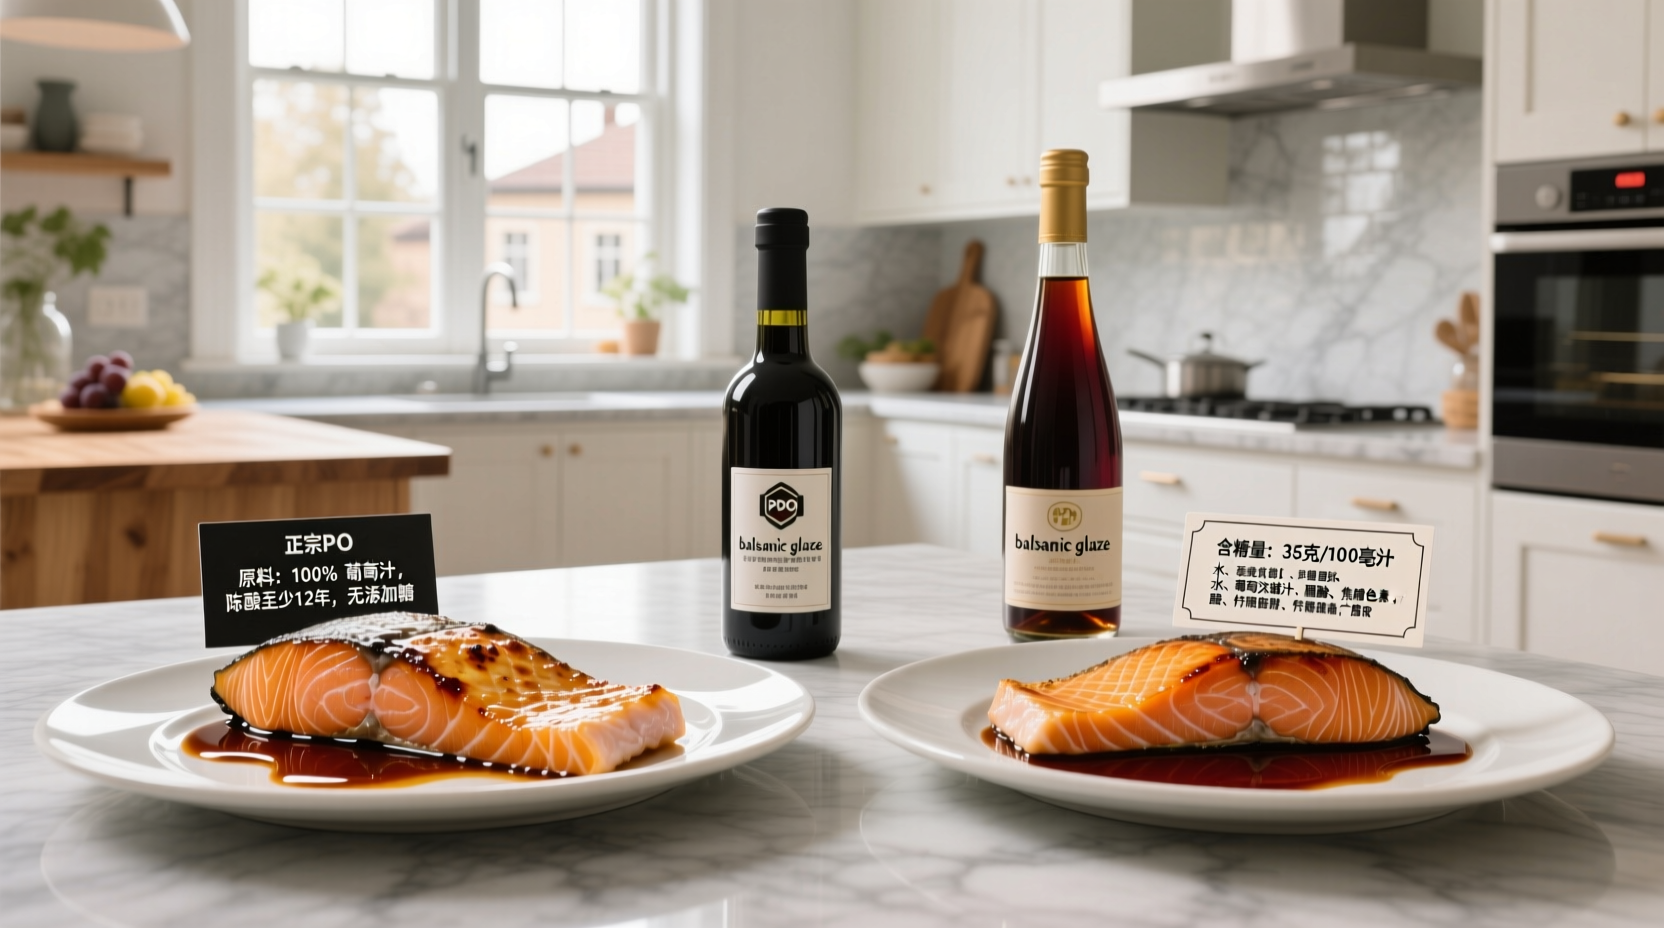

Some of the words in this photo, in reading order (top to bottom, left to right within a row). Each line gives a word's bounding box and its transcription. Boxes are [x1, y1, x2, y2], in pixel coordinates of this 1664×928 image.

[768, 499, 798, 512] PDO
[284, 532, 354, 555] 正宗PO
[1015, 533, 1072, 552] balsanic
